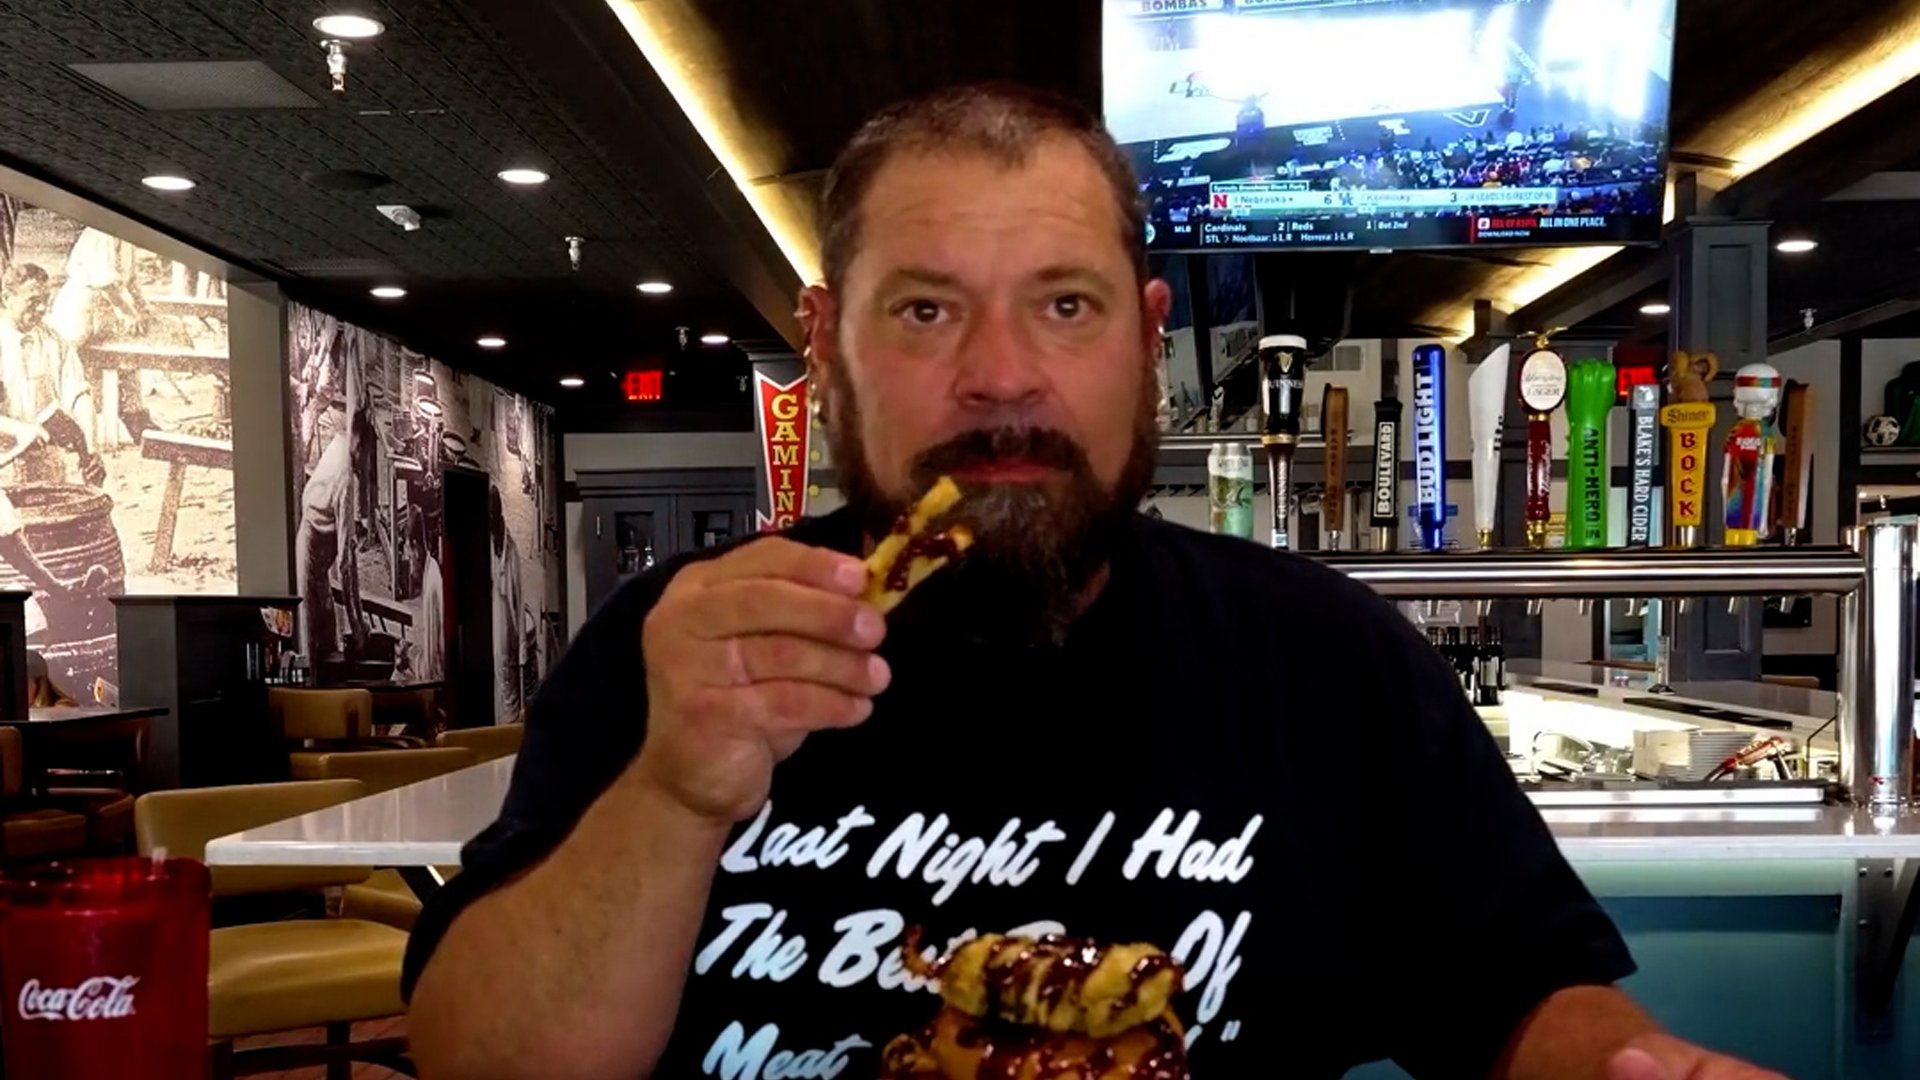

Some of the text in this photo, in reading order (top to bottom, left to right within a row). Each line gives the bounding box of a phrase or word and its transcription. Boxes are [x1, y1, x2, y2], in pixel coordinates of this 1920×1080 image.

[1174, 225, 1192, 233] MLB
[1205, 222, 1247, 232] Cardinals
[1278, 222, 1285, 231] 2
[1292, 222, 1314, 231] Reds
[1324, 193, 1333, 205] 6
[1450, 191, 1458, 203] 3
[1539, 217, 1553, 228] ALL
[1564, 217, 1580, 228] ONE
[1205, 234, 1221, 243] STL
[771, 393, 800, 529] GAMING
[1377, 424, 1394, 514] BOULEVARD
[1414, 372, 1436, 504] BUD LIGHT
[1679, 432, 1697, 516] BOCK
[1583, 427, 1601, 523] ANTI-HERO
[1631, 415, 1653, 541] BLAKE'S HARD CIDER
[720, 799, 1264, 906] Last Night I Had
[18, 975, 140, 1021] Coca-Cola
[695, 903, 808, 984] The
[1170, 909, 1252, 1024] Of
[702, 1020, 873, 1080] Meat
